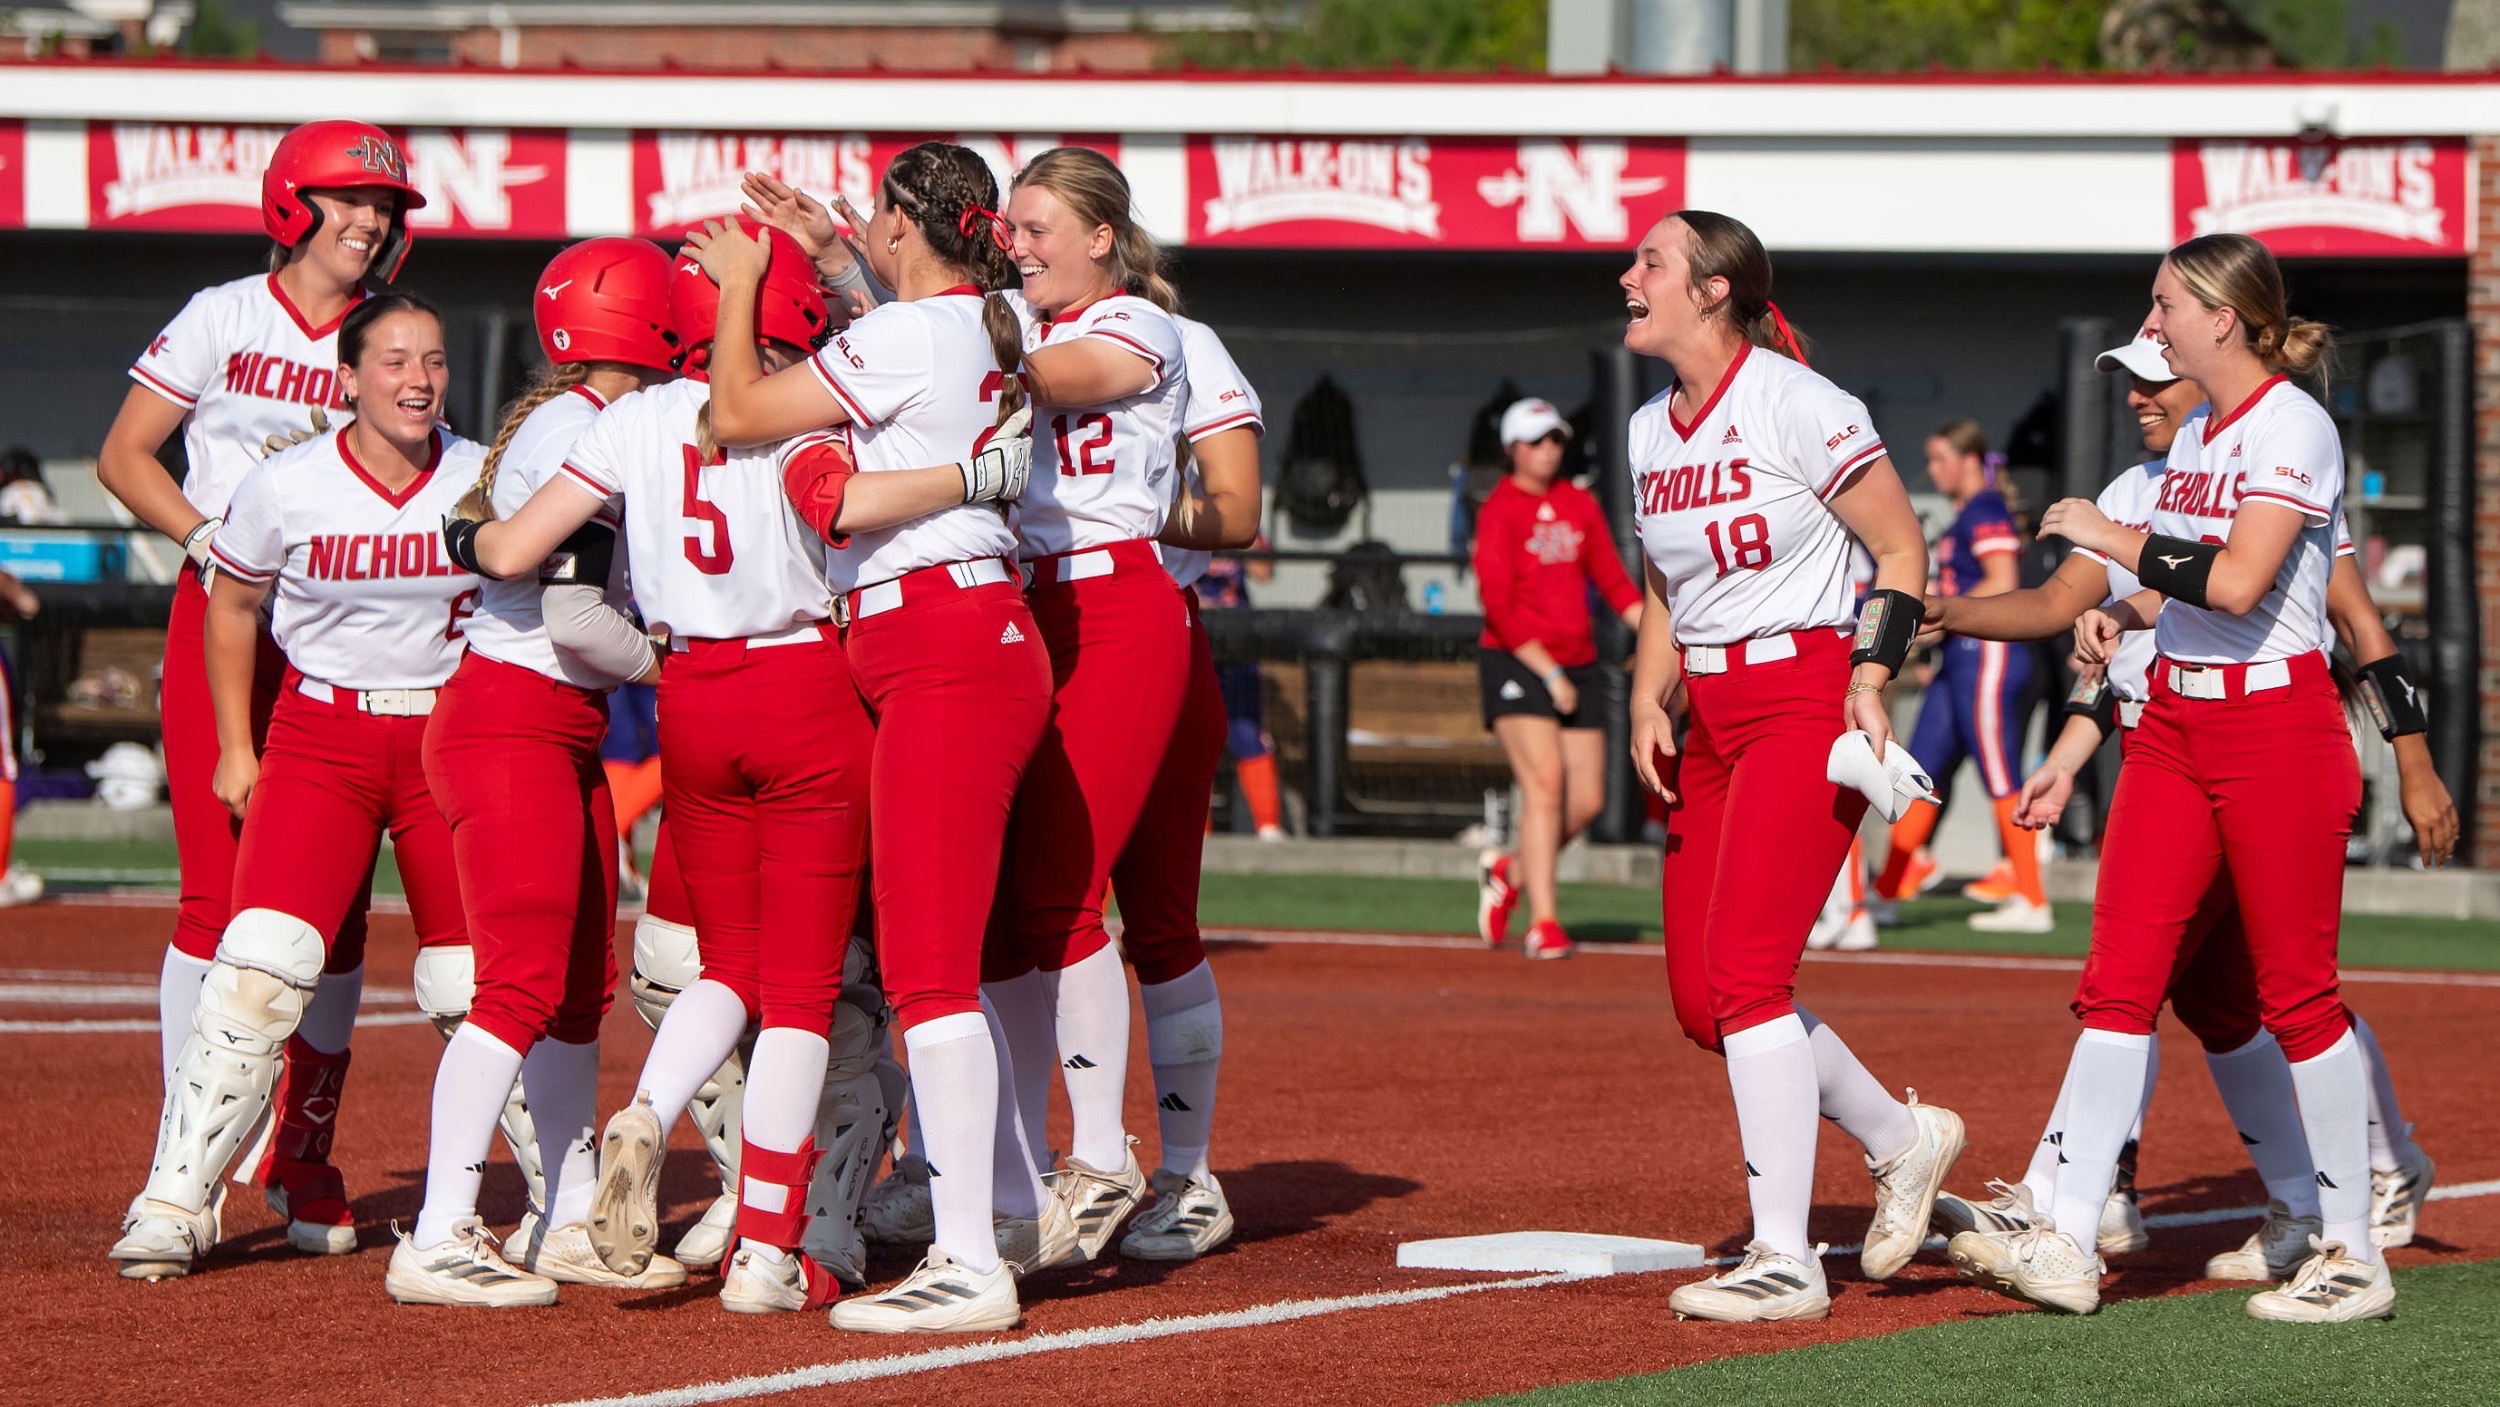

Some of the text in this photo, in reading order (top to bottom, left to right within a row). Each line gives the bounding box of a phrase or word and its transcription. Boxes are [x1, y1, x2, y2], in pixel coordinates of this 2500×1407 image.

[1516, 137, 1630, 242] N
[1219, 389, 1249, 403] SL
[1051, 412, 1116, 478] 12
[676, 442, 735, 576] 5
[1704, 512, 1773, 579] 18
